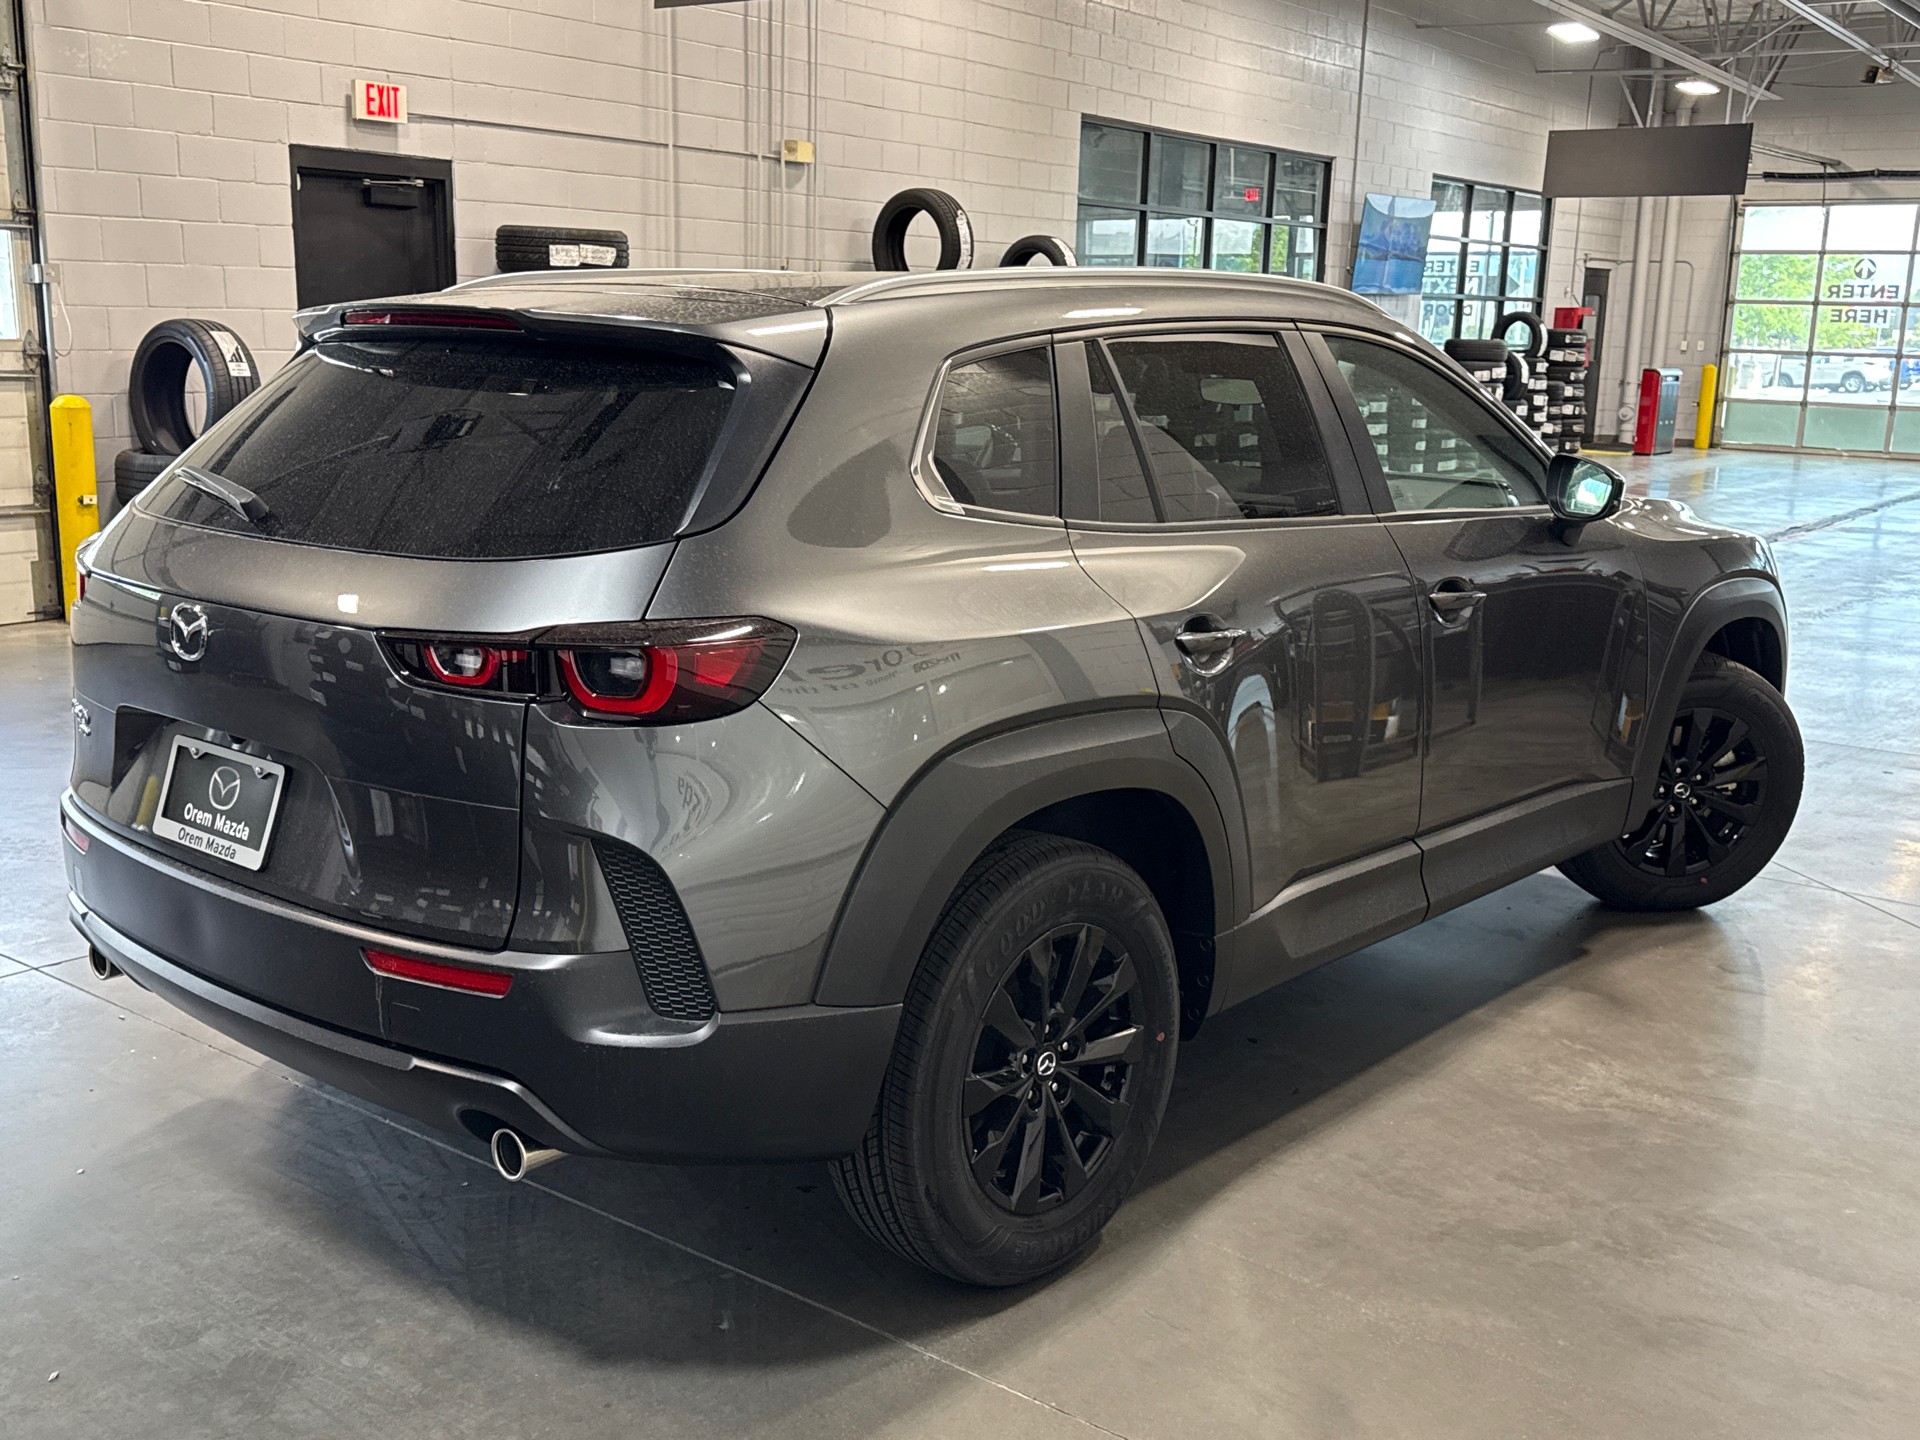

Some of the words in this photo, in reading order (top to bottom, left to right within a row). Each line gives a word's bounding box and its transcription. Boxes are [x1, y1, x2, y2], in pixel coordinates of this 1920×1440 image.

[365, 82, 400, 119] EXIT
[184, 803, 212, 827] Orem
[214, 813, 250, 840] Mazda
[178, 827, 203, 847] Orem
[205, 837, 237, 859] Mazda
